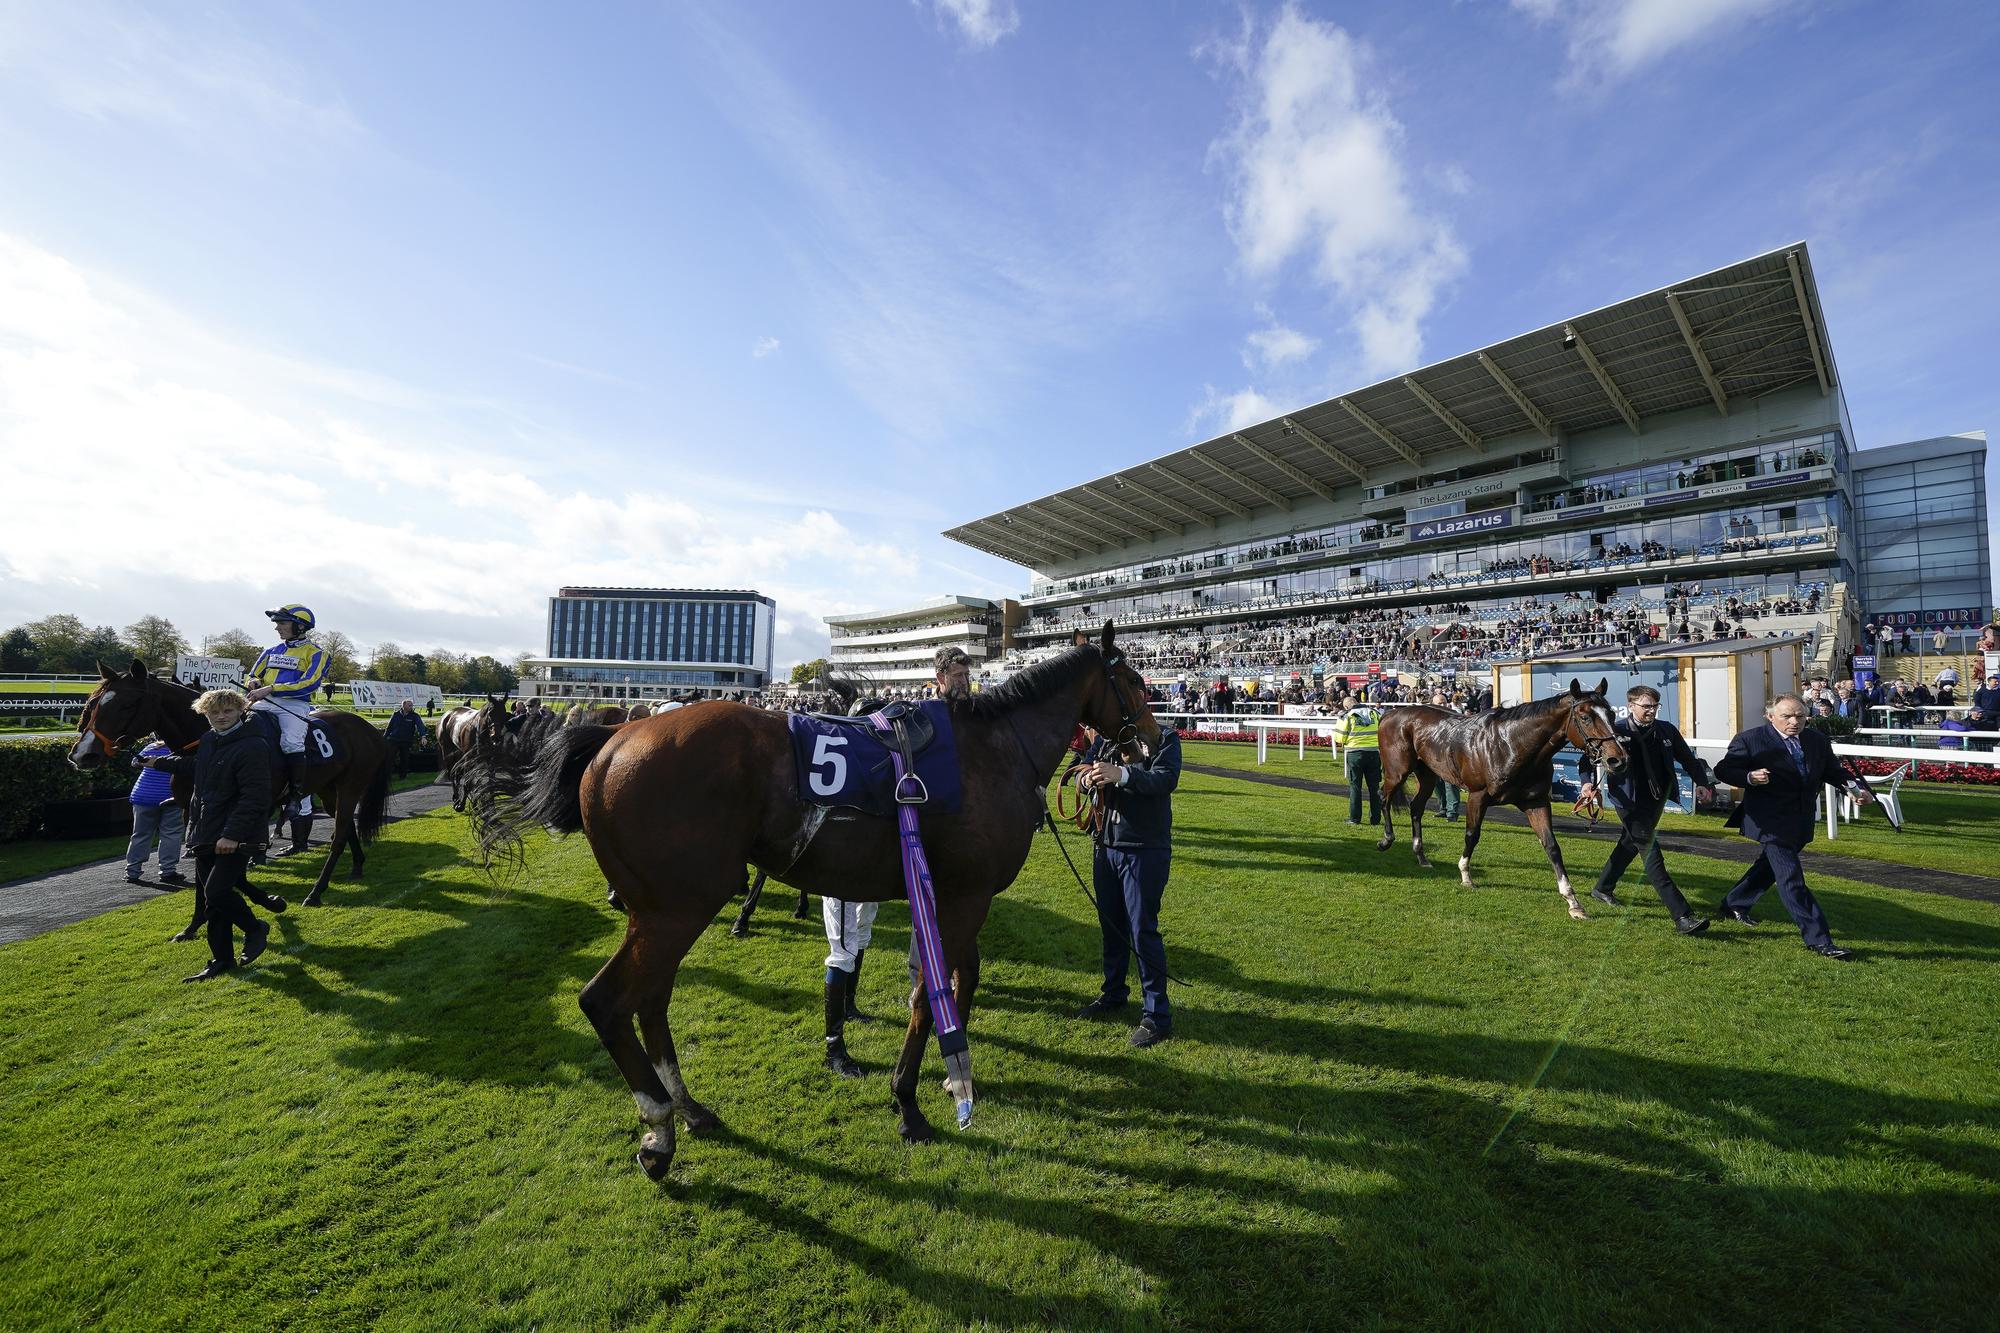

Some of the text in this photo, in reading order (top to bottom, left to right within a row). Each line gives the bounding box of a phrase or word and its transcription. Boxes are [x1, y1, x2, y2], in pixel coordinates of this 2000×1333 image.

[1419, 481, 1503, 505] The Lazarus Stand
[1711, 485, 1743, 494] Lazarus
[1437, 514, 1502, 534] Lazarus
[1878, 608, 1979, 625] FOOD COURT
[184, 658, 235, 670] The vertem
[182, 672, 234, 683] FUTURITY
[0, 700, 81, 709] OTT DOBSON
[312, 728, 334, 758] 8
[809, 734, 848, 796] 5
